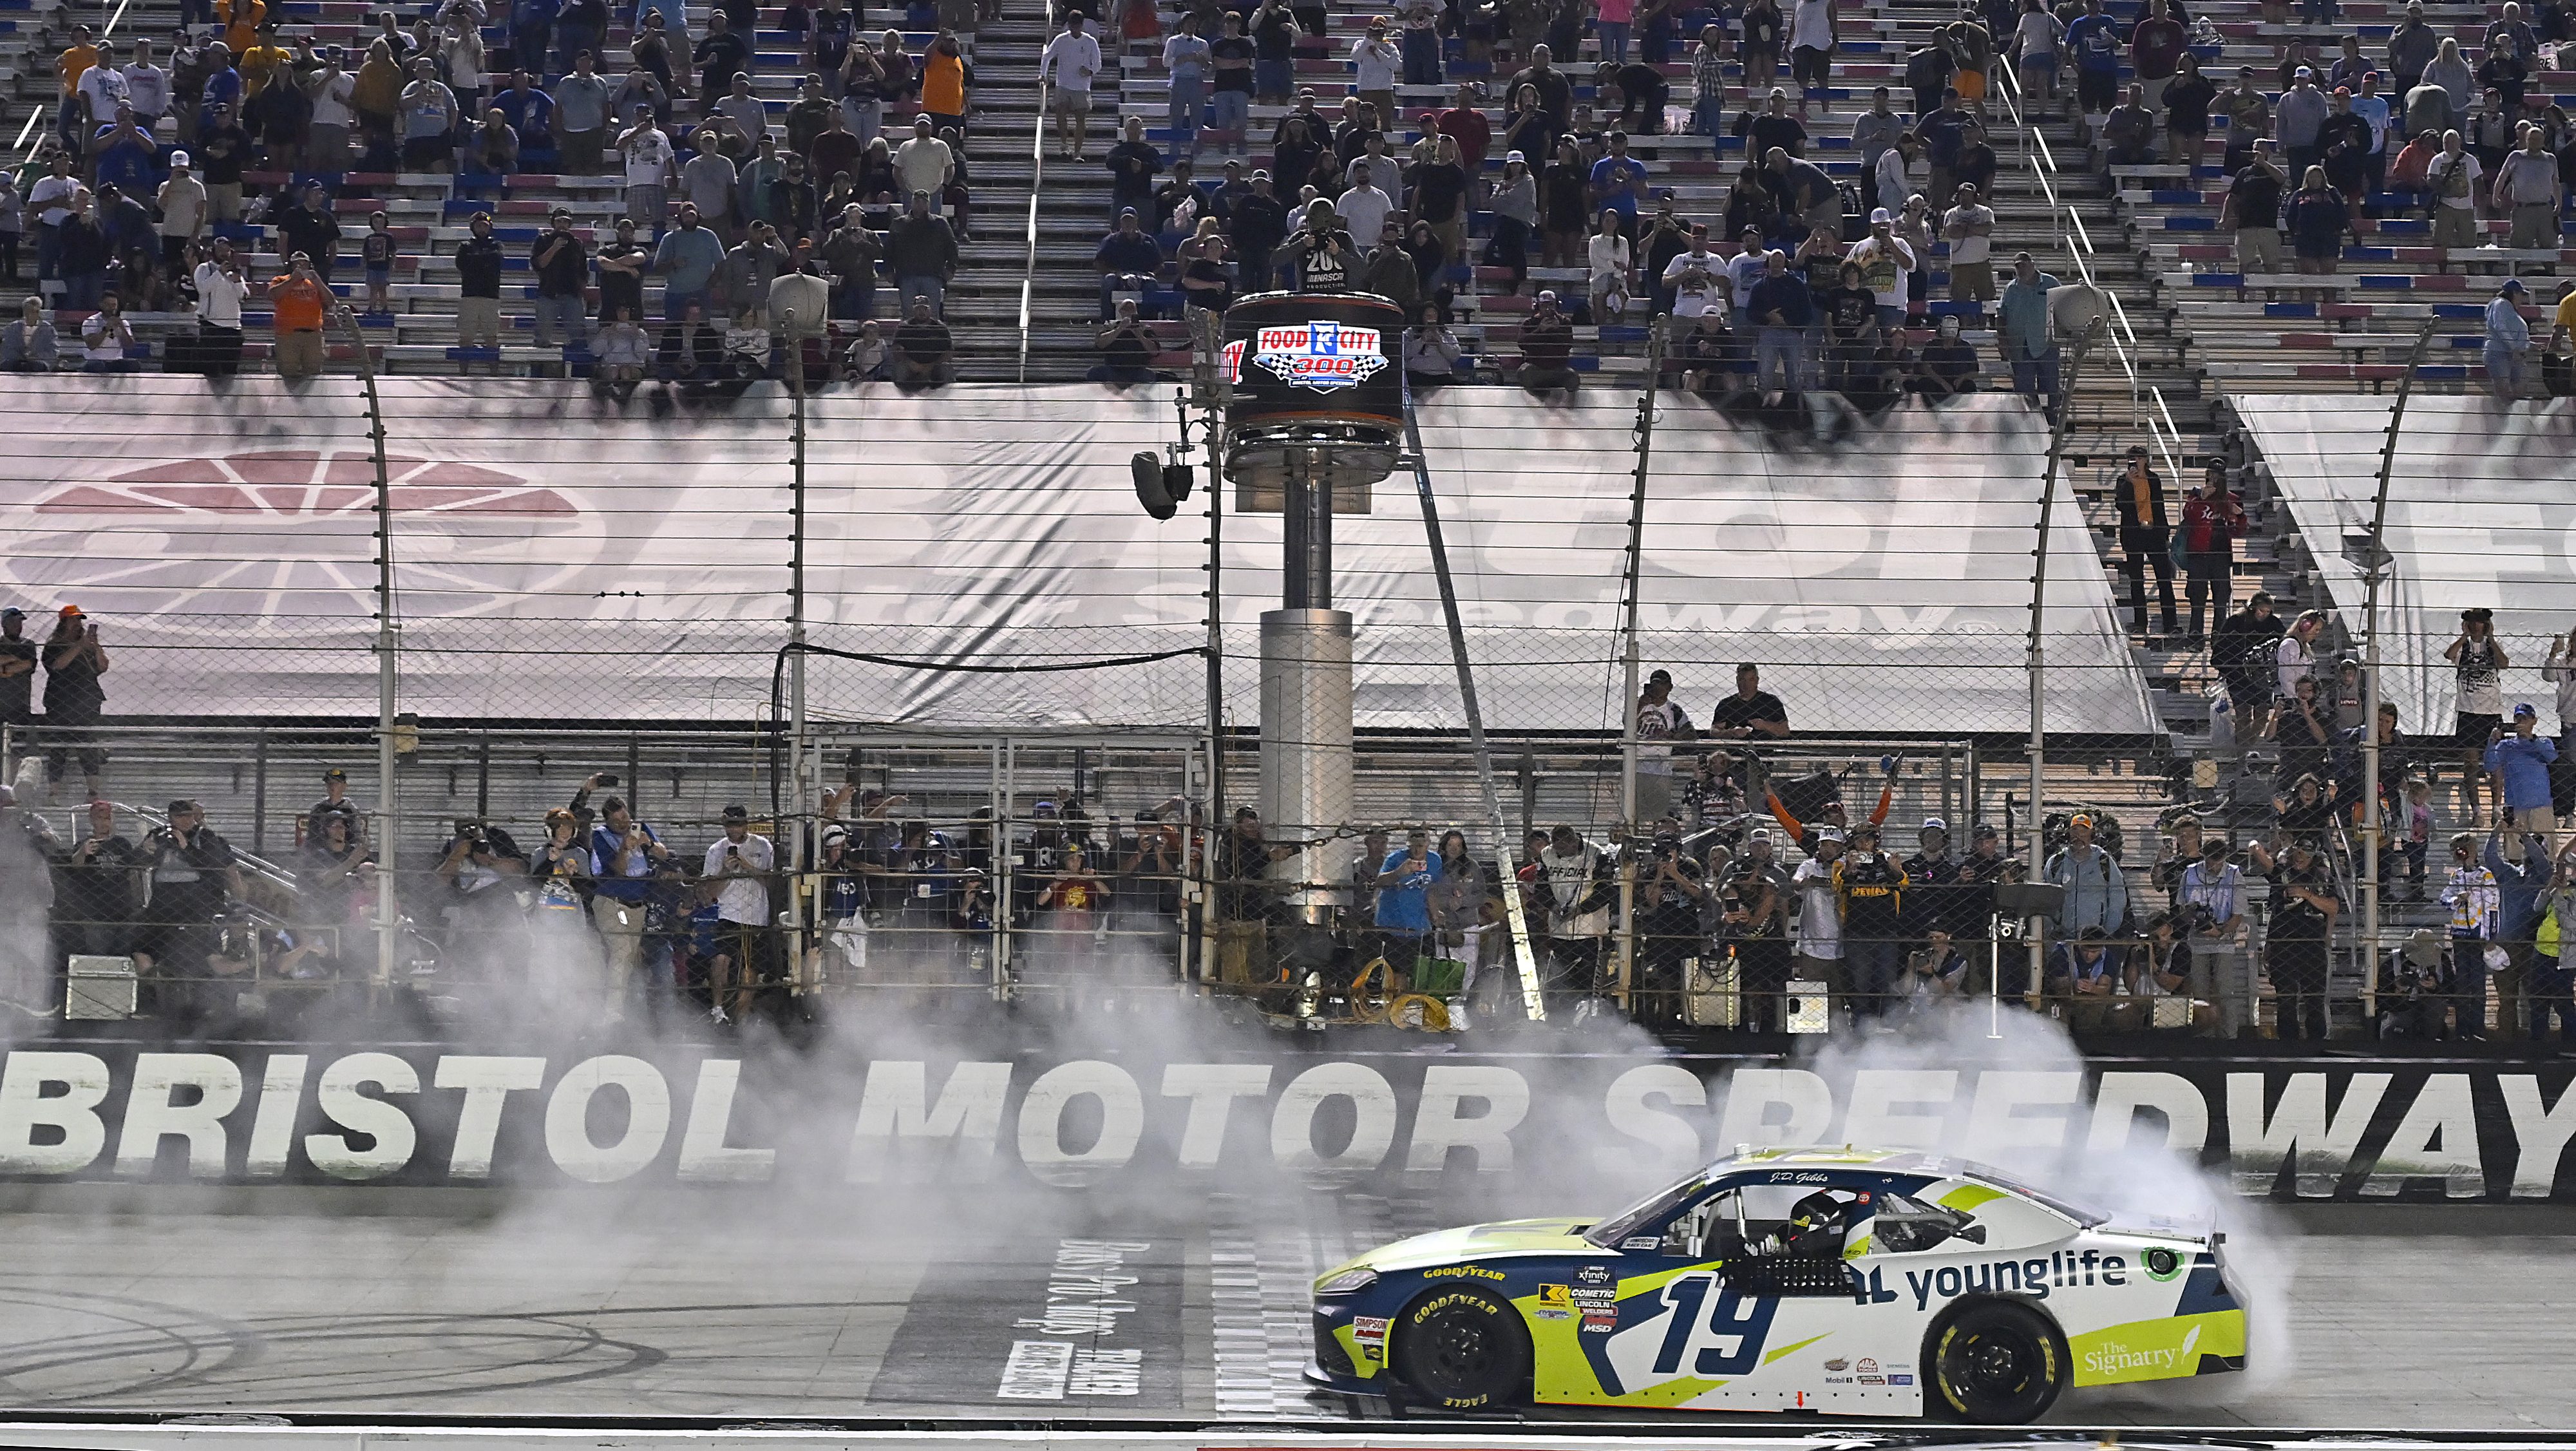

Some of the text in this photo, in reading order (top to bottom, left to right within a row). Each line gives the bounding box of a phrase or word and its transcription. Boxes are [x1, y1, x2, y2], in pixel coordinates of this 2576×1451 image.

[1262, 330, 1308, 350] FOOD
[1340, 330, 1376, 350] CITY
[1293, 357, 1355, 375] 300
[0, 1051, 2576, 1199] BRISTOL MOTOR SPEEDWAY
[1770, 1172, 1828, 1184] J.D. Gibbs
[1423, 1265, 1506, 1281] GOODYEAR
[1578, 1270, 1610, 1282] xfinity
[1906, 1249, 2126, 1312] younglife
[1571, 1289, 1616, 1298] COMETIC
[1414, 1294, 1498, 1324] GOODYEAR
[1356, 1317, 1387, 1330] SIMPSON
[1584, 1325, 1612, 1333] MSD
[1652, 1267, 1781, 1375] 19
[2101, 1341, 2127, 1354] The
[2085, 1348, 2176, 1376] Signatry
[1068, 1349, 1142, 1396] TRACKER
[1443, 1394, 1488, 1408] EAGLE
